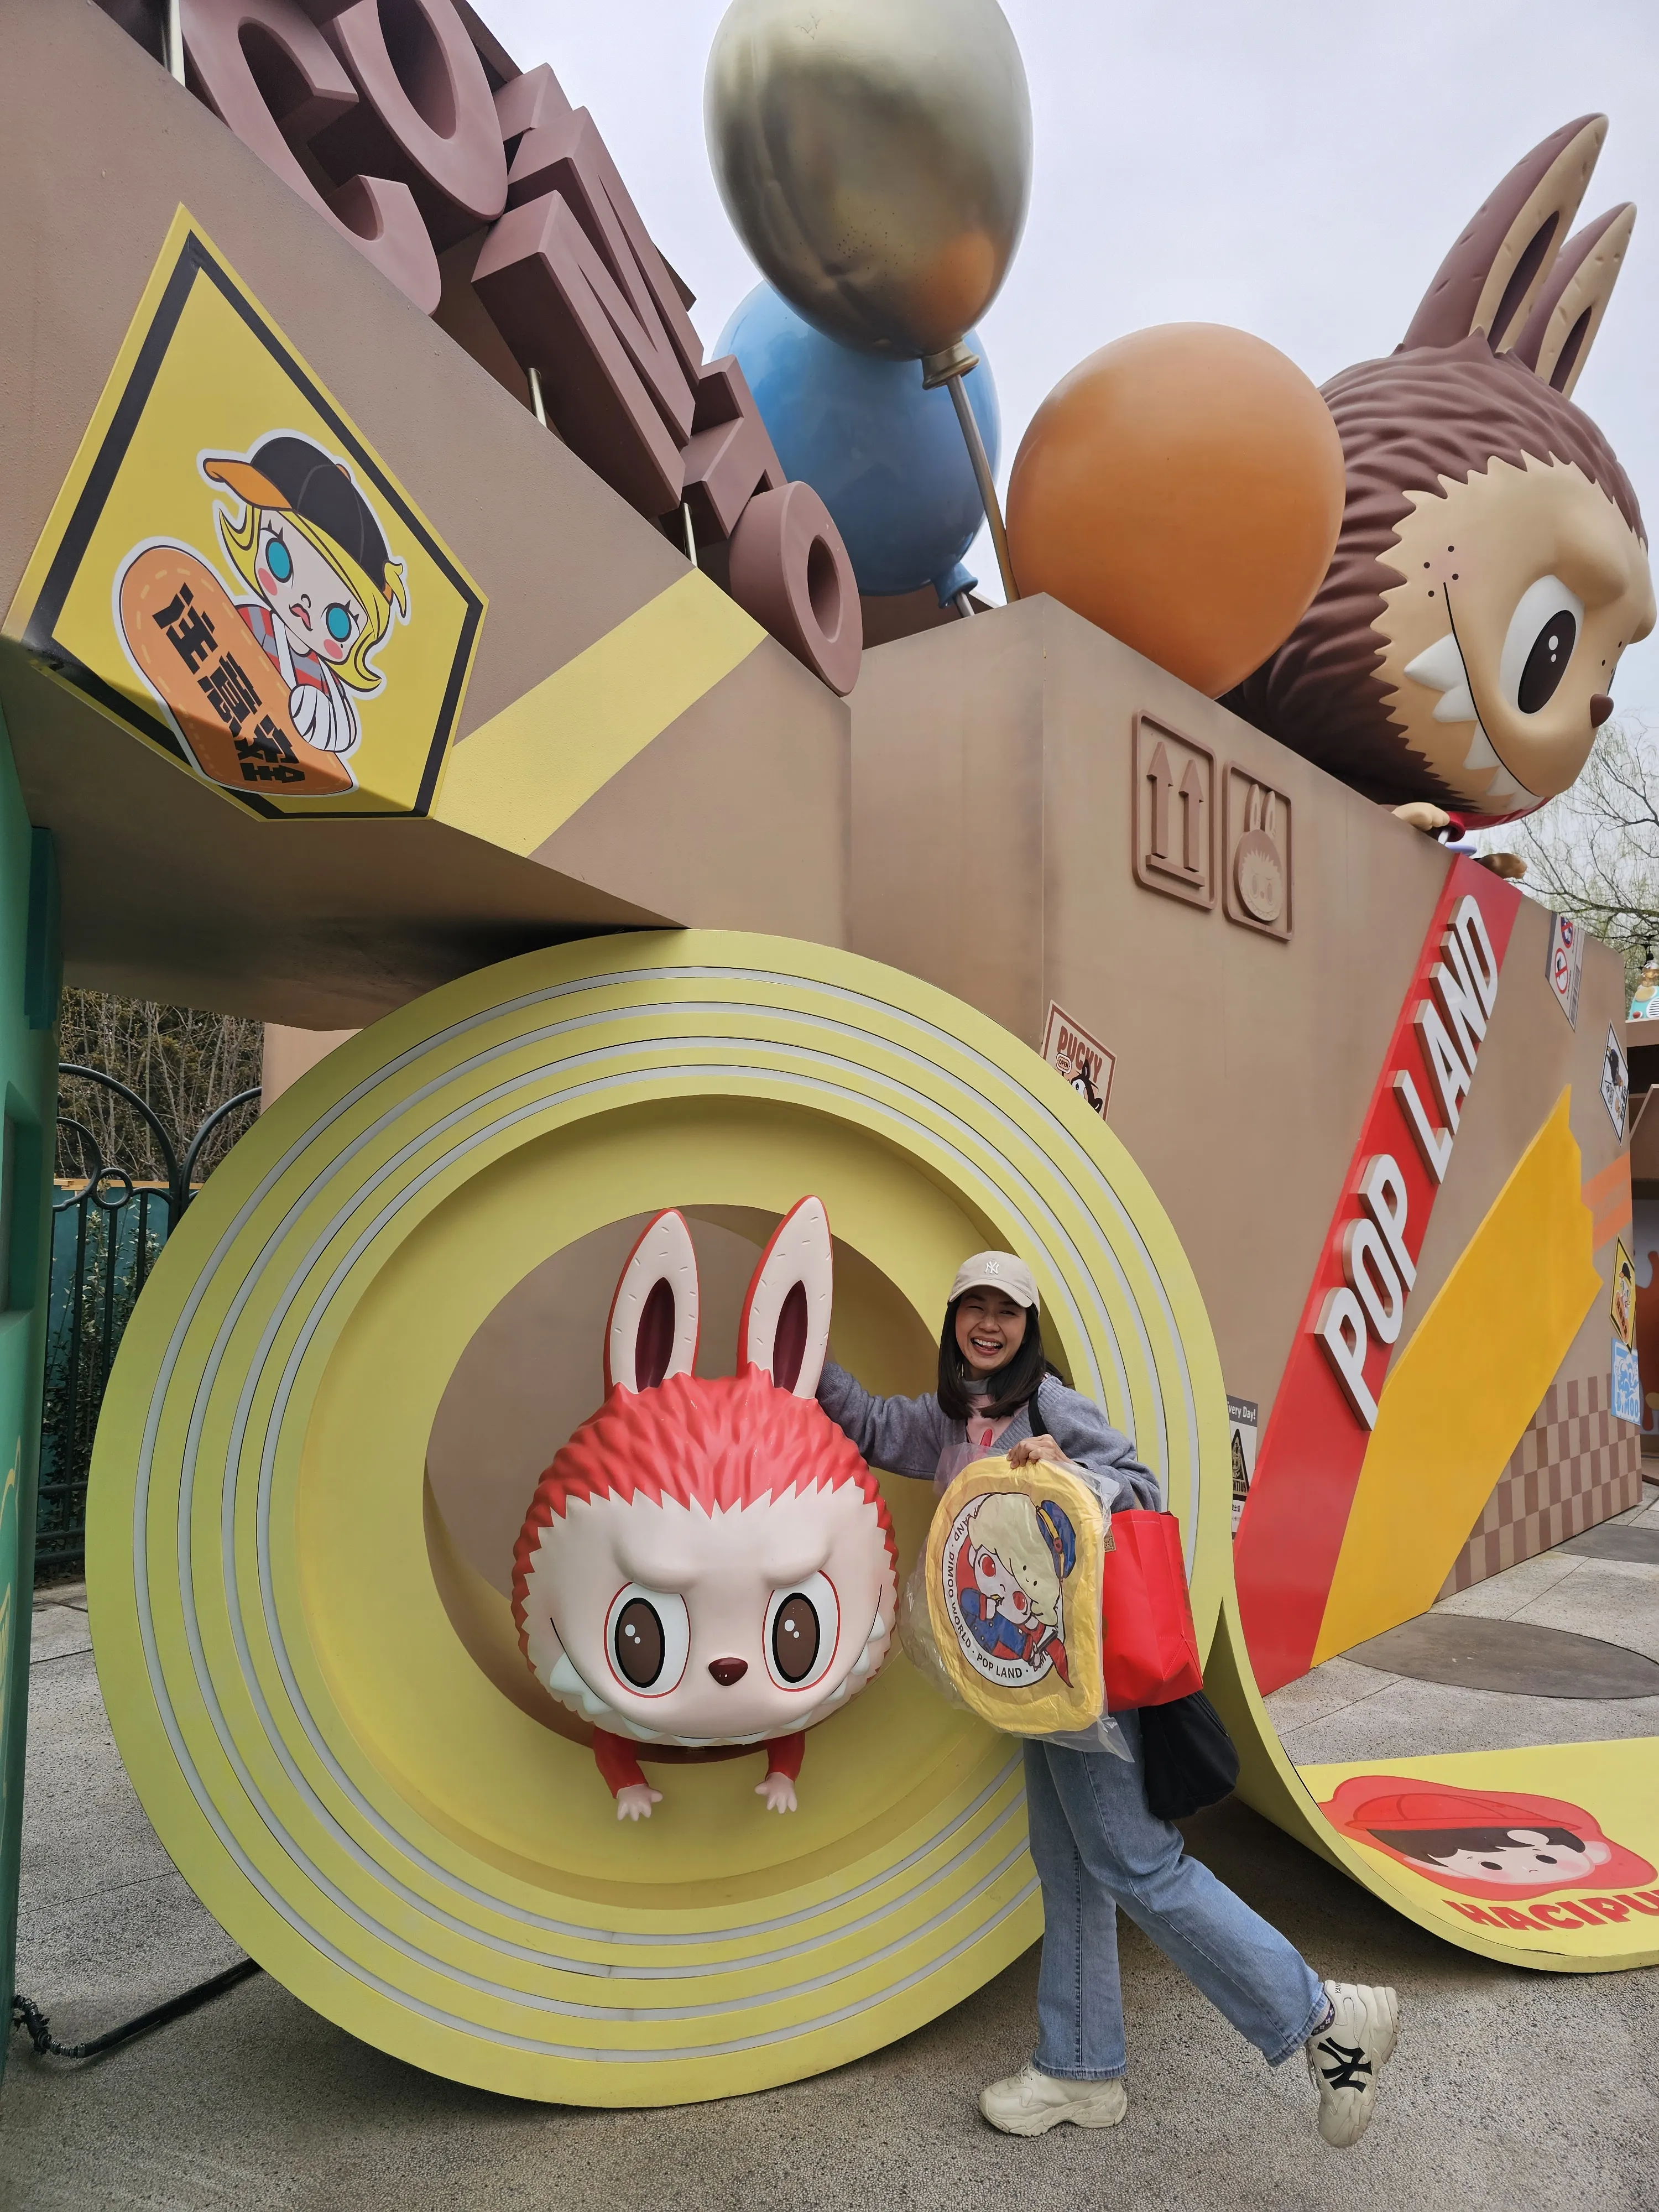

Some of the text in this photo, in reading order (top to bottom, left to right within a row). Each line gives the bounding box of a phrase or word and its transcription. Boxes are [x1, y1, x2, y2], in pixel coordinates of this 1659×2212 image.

[152, 582, 305, 784] 注意安全
[1057, 1025, 1103, 1084] PUCKY
[1058, 1058, 1069, 1068] OPEN
[1314, 894, 1498, 1432] POP LAND
[984, 1261, 1000, 1275] NY
[1227, 1401, 1256, 1422] very Day!
[1616, 1391, 1639, 1419] DIMOO
[951, 1601, 972, 1648] WORLD
[977, 1652, 994, 1672] POP
[996, 1665, 1022, 1679] LAND
[1317, 2036, 1373, 2094] NY
